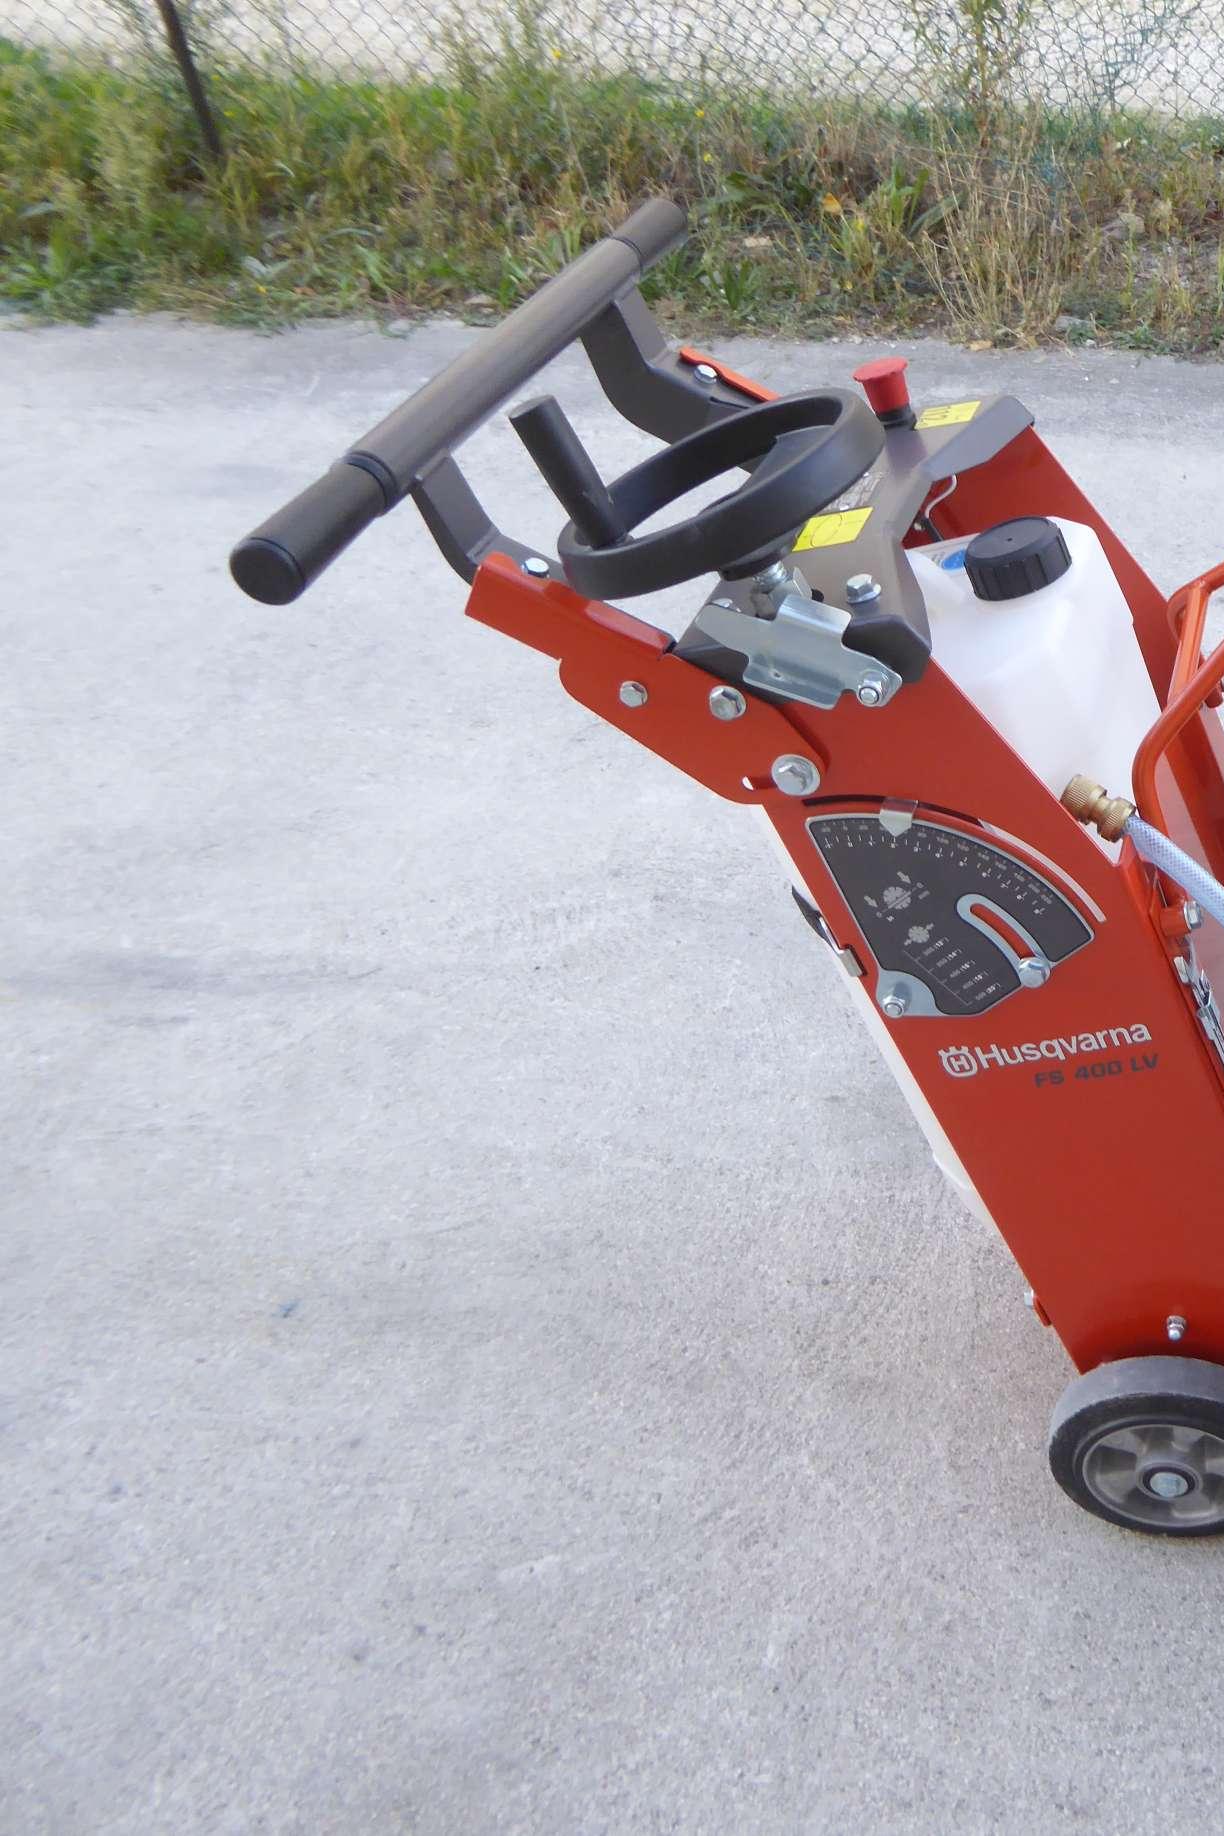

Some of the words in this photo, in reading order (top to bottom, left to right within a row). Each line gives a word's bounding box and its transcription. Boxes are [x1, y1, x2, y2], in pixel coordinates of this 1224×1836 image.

[974, 1023, 1152, 1069] Husqvarna
[1034, 1069, 1065, 1088] FS
[1074, 1059, 1123, 1081] 400
[1130, 1053, 1160, 1073] LV
